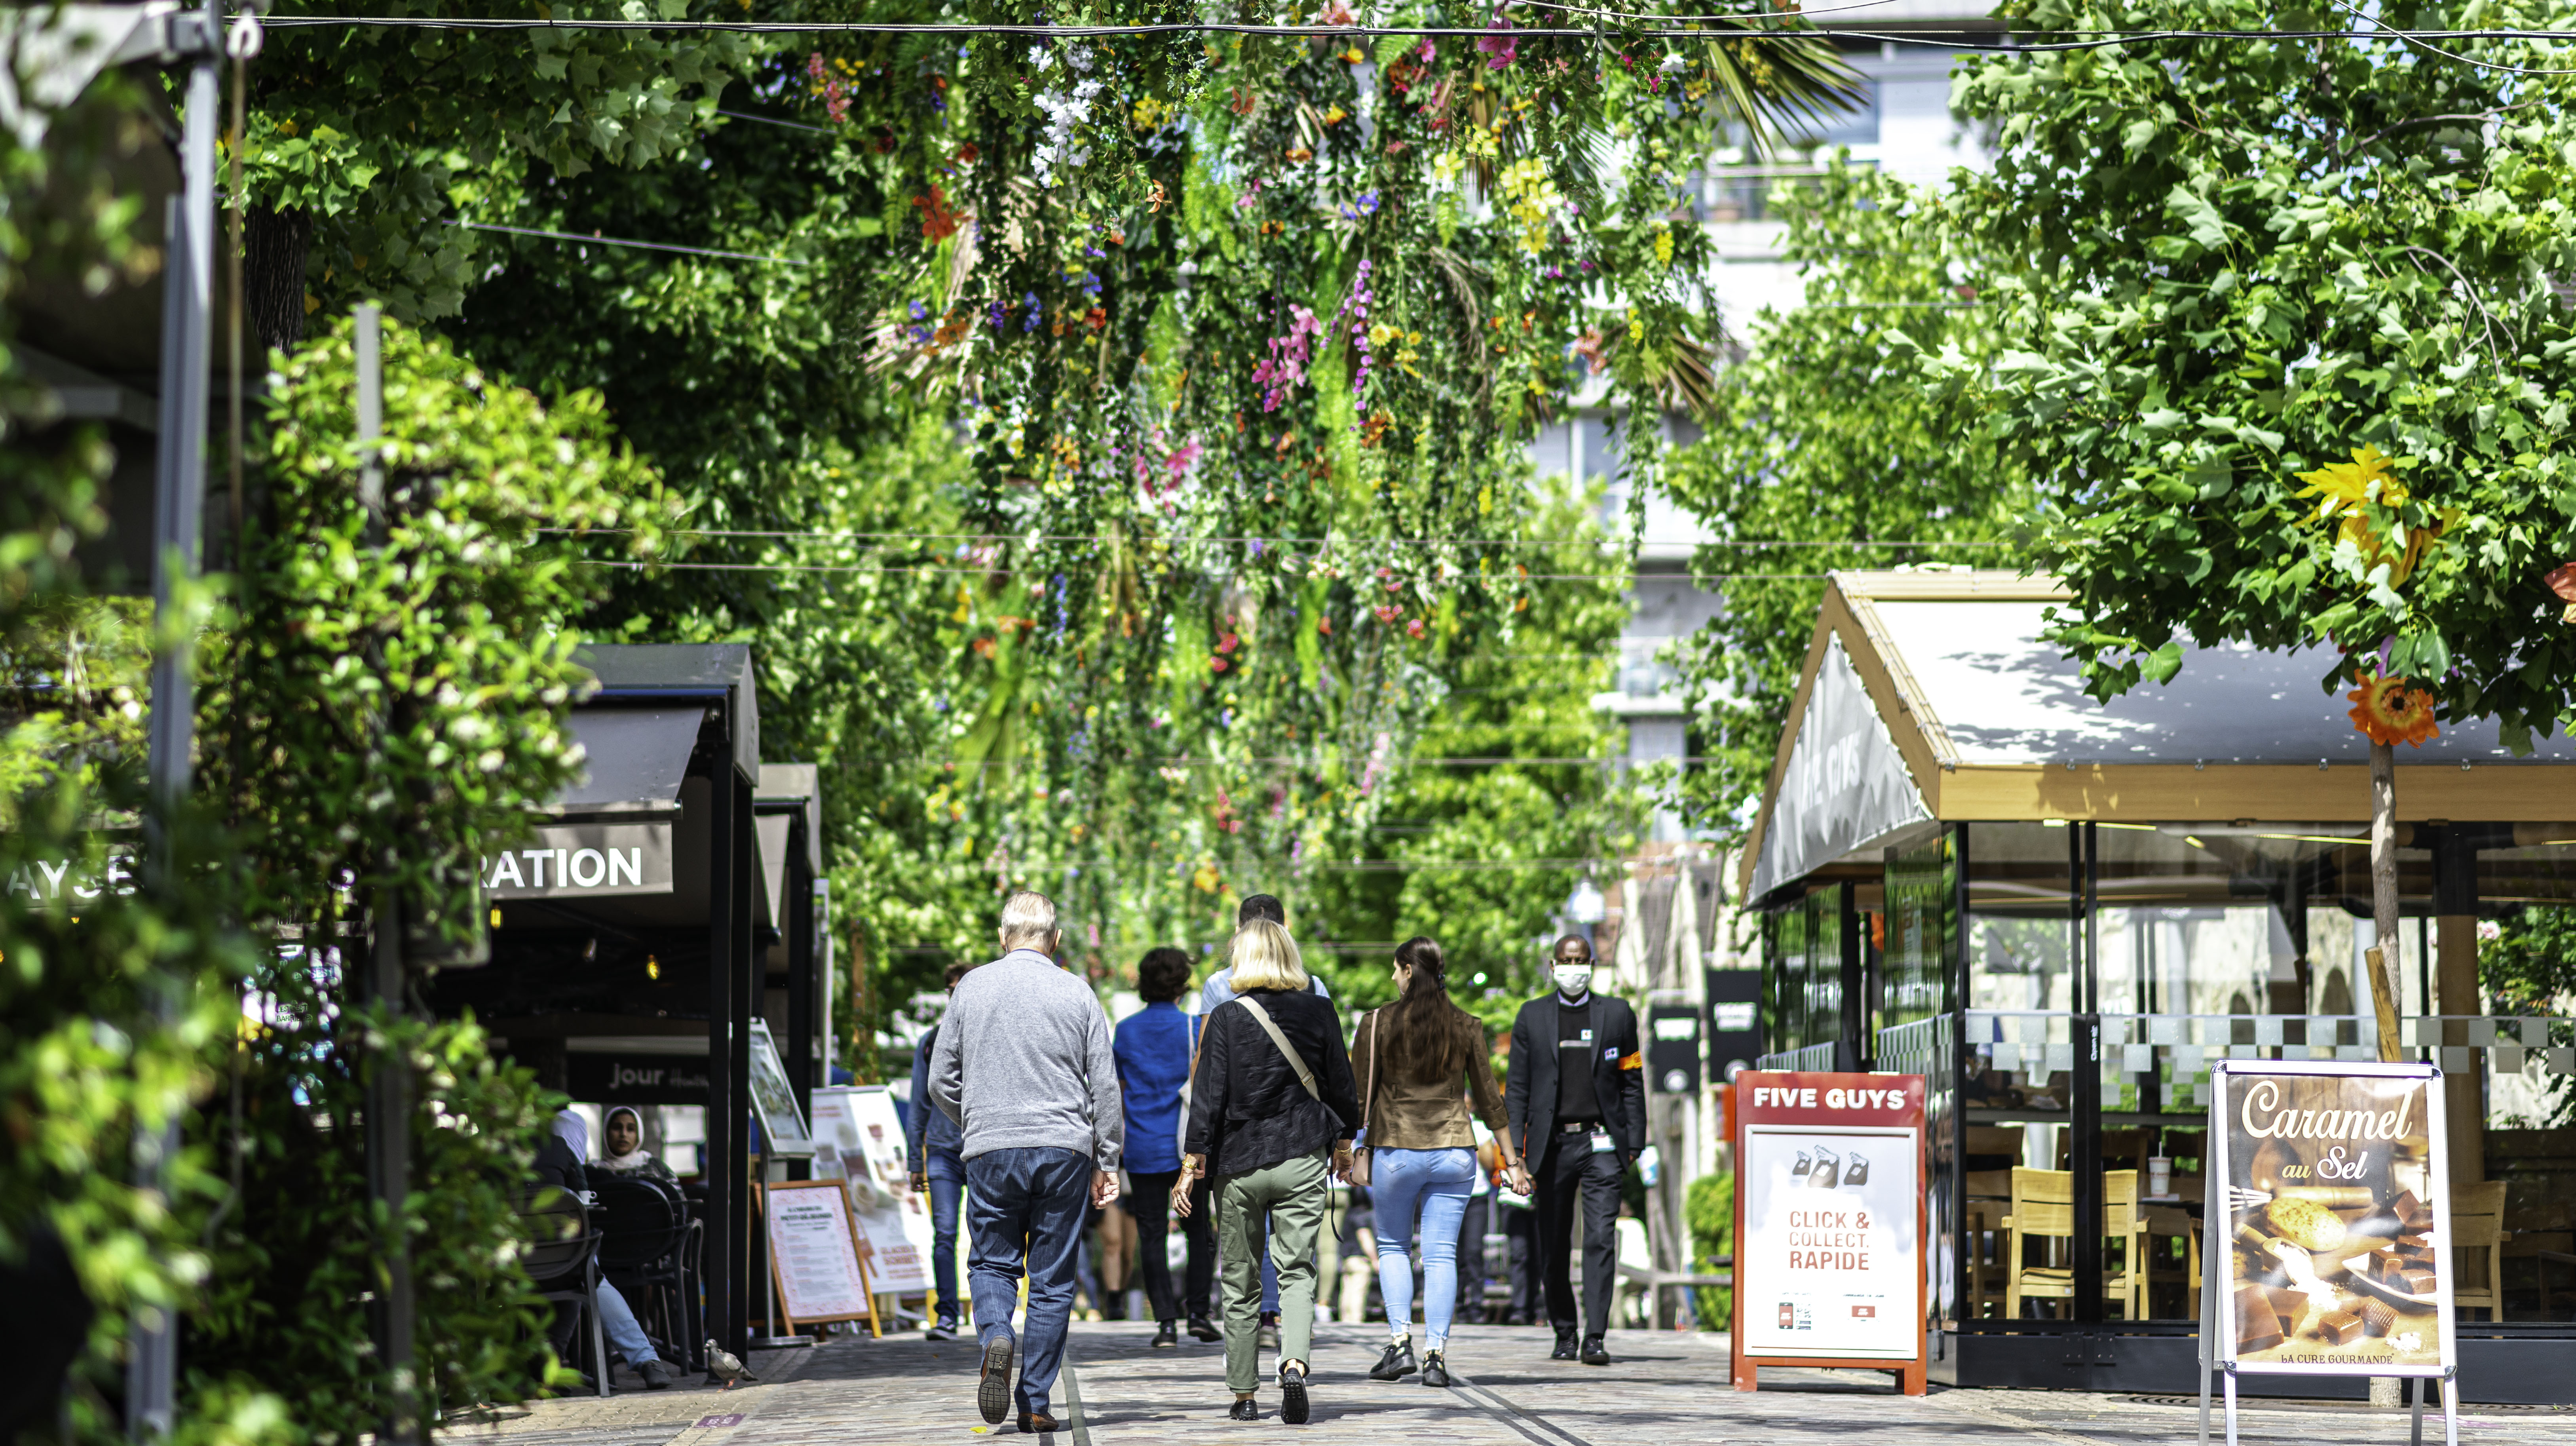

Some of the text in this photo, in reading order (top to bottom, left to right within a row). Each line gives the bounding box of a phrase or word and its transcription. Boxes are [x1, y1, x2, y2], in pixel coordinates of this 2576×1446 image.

[1753, 1087, 1906, 1110] FIVE GUYS
[2242, 1080, 2413, 1140] Caramel
[2282, 1145, 2368, 1180] au Sel
[1790, 1211, 1869, 1229] CLICK &
[1789, 1231, 1869, 1248] COLLECT.
[1790, 1250, 1869, 1270] RAPIDE
[2281, 1354, 2393, 1364] LA CURE GOURMANDE
